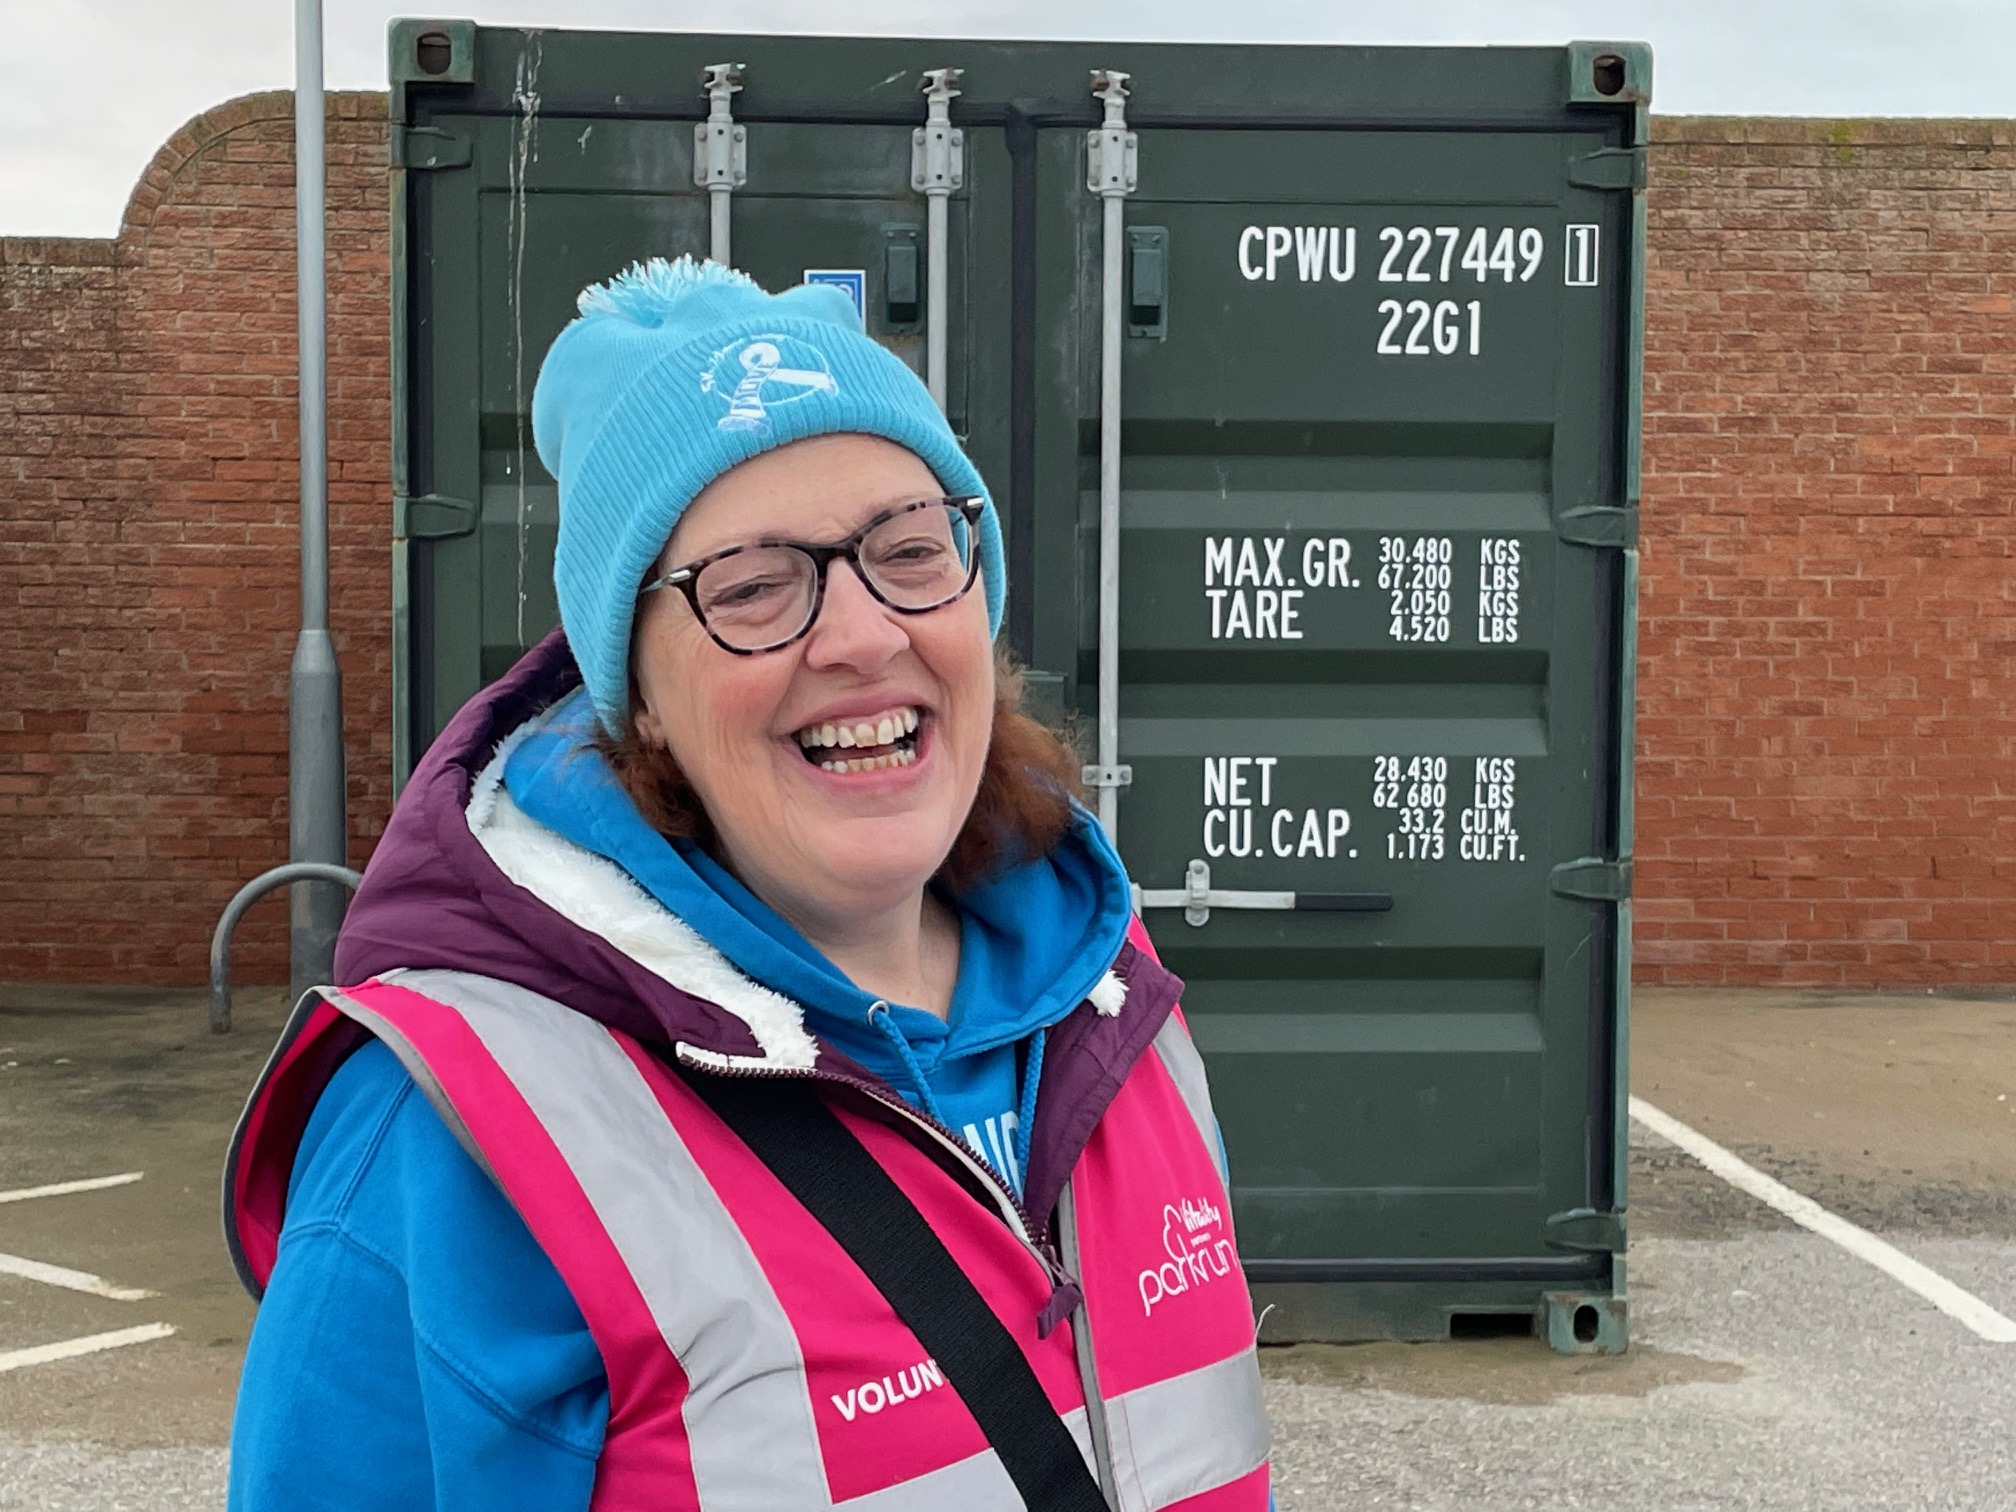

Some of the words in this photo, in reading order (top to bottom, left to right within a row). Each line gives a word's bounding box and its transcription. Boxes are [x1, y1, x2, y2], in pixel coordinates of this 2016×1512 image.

[1238, 225, 1356, 282] CPWU
[1378, 226, 1543, 283] 227449
[1376, 299, 1481, 356] 22G1
[1205, 536, 1360, 588] MAX.GR.
[1378, 536, 1452, 564] 30.480
[1480, 538, 1520, 565] KGS
[1377, 564, 1451, 590] 67.200
[1479, 565, 1520, 591] LBS
[1205, 589, 1304, 639] TARE
[1390, 590, 1451, 616] 2.050
[1479, 592, 1519, 617] KGS
[1389, 616, 1450, 642] 4.520
[1478, 617, 1518, 643] LBS
[1204, 757, 1278, 807] NET
[1373, 756, 1447, 782] 28.430
[1475, 757, 1515, 783] KGS
[1474, 784, 1514, 809] LBS
[1203, 808, 1357, 858] CU.CAP.
[1398, 808, 1445, 834] 33.2
[1460, 808, 1516, 835] CU.M.
[1387, 833, 1444, 860] 1.173
[1460, 834, 1526, 862] CU.FT.
[1138, 1233, 1240, 1317] parkrun
